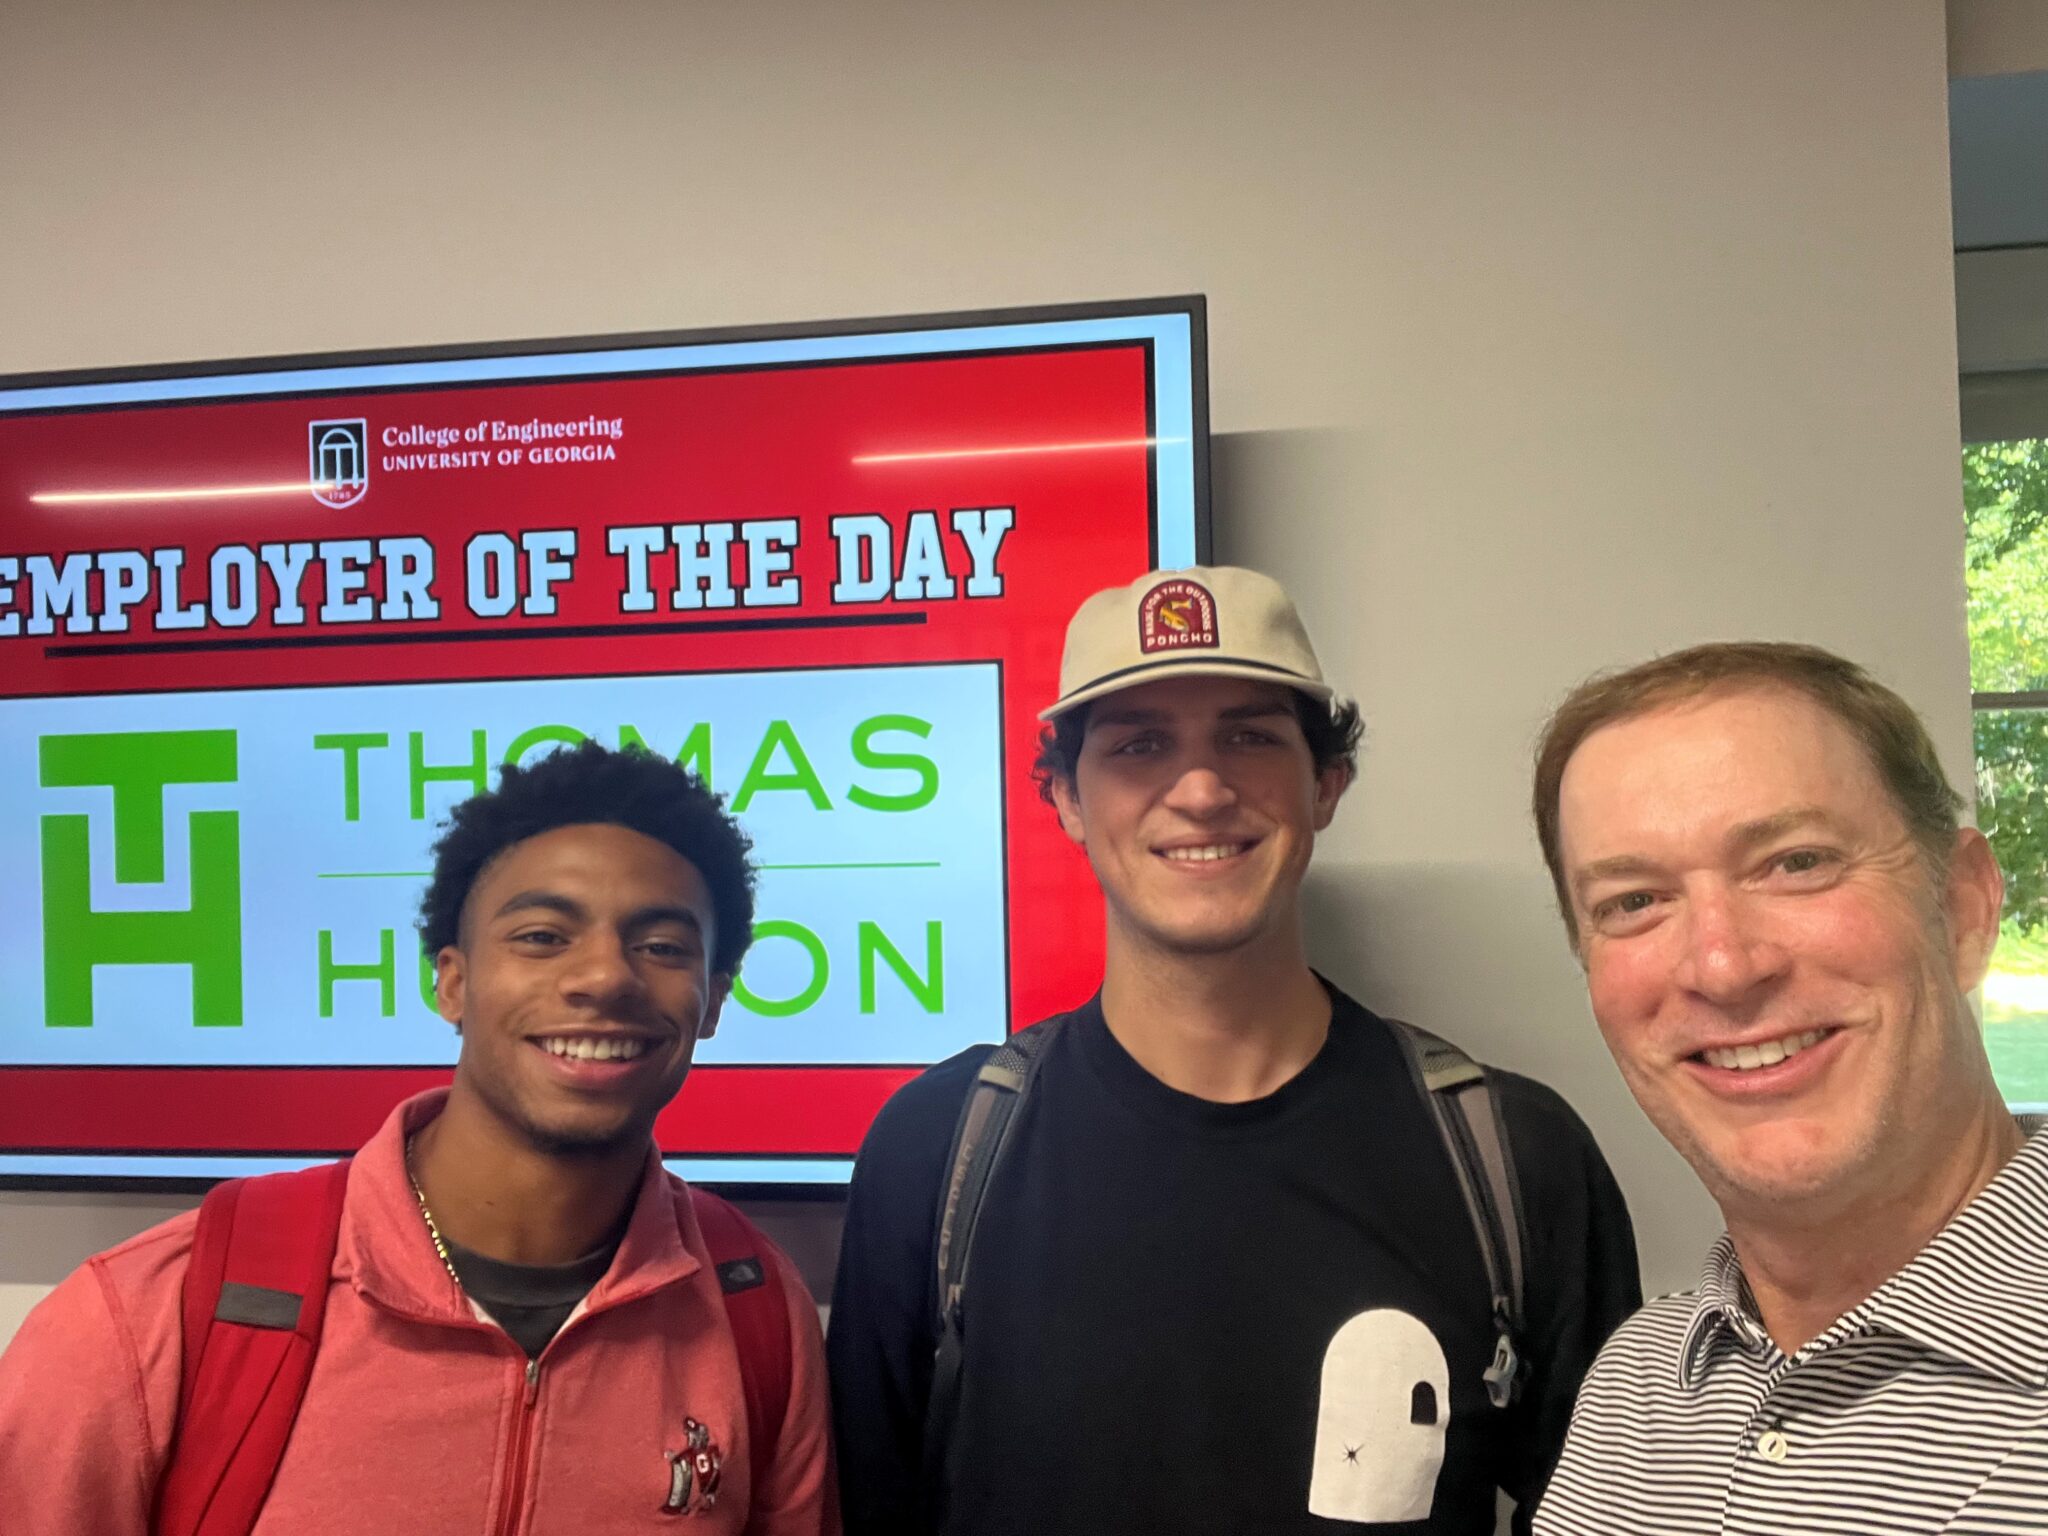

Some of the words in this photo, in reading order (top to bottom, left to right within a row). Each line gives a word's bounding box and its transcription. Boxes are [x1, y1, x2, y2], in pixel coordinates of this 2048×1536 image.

[382, 424, 460, 447] College
[465, 421, 487, 442] of
[492, 416, 623, 444] Engineering
[382, 451, 491, 471] UNIVERSITY
[498, 448, 522, 465] OF
[529, 445, 616, 464] GEORGIA
[465, 528, 576, 617] OF
[608, 519, 801, 612] THE
[831, 506, 1015, 602] DAY
[1162, 585, 1183, 595] THE
[1146, 632, 1212, 648] PONCHO
[317, 919, 944, 1018] HON
[696, 1453, 709, 1474] G
